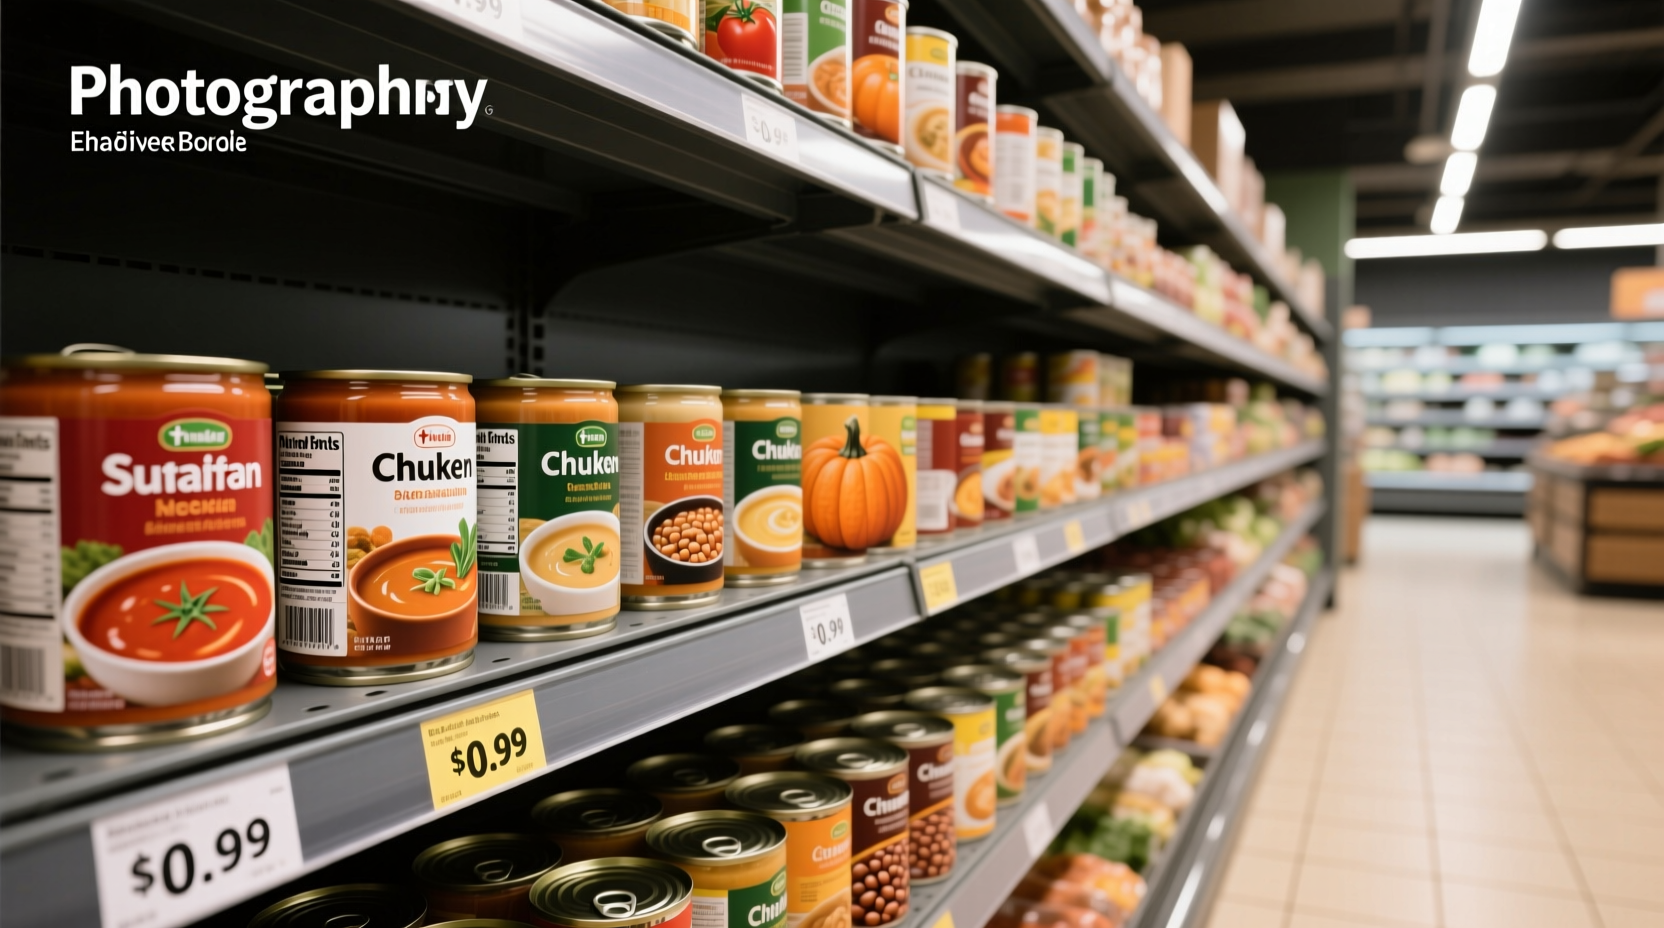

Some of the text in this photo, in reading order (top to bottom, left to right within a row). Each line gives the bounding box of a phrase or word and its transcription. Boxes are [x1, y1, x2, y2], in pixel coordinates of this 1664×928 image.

[372, 451, 472, 482] Chuken
[541, 450, 619, 476] Chuken
[450, 726, 527, 779] $0.99
[131, 818, 271, 898] $0.99
